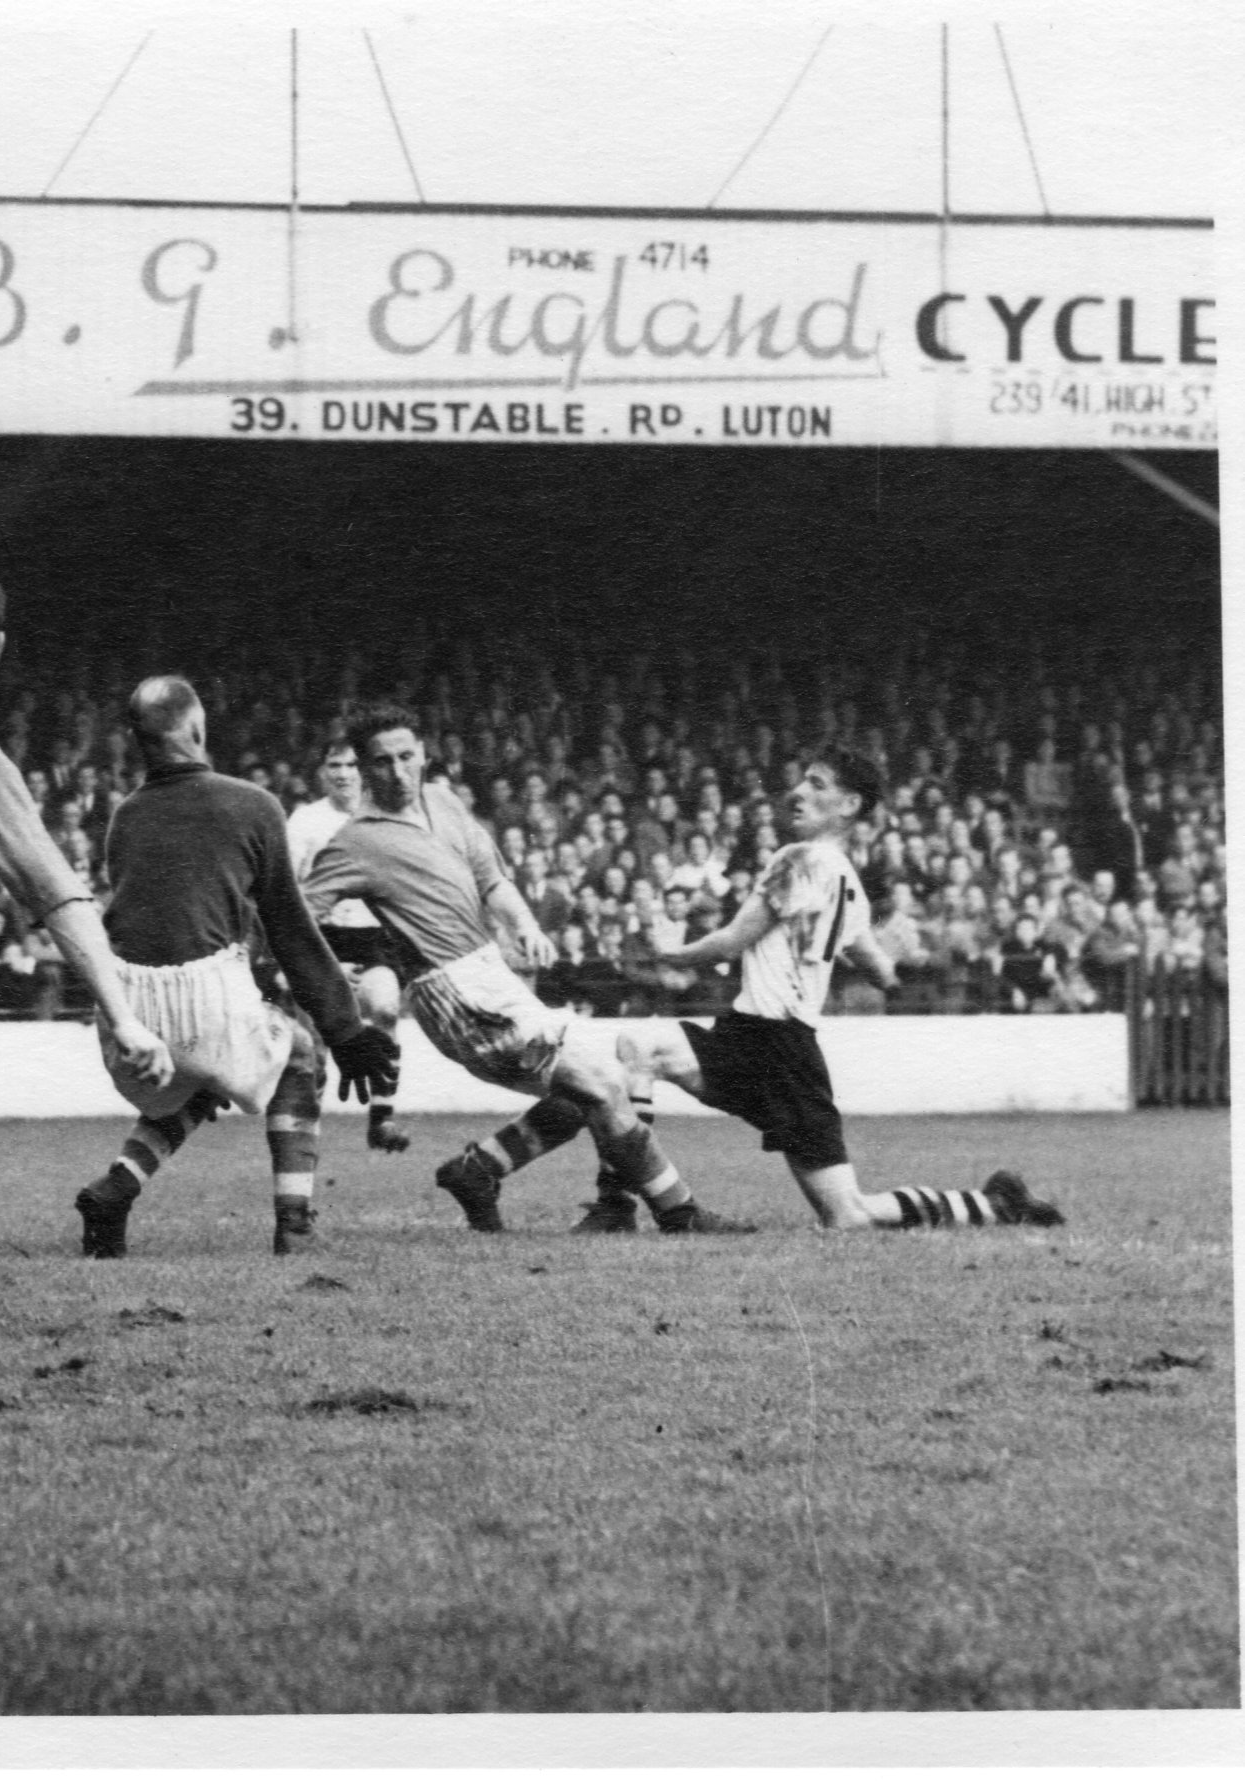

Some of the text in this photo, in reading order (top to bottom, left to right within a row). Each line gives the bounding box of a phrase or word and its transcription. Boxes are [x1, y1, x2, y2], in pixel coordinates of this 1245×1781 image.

[509, 242, 710, 272] PHONE 4714
[367, 245, 881, 392] England
[915, 292, 1218, 366] CYCLE
[723, 405, 832, 437] LUTON
